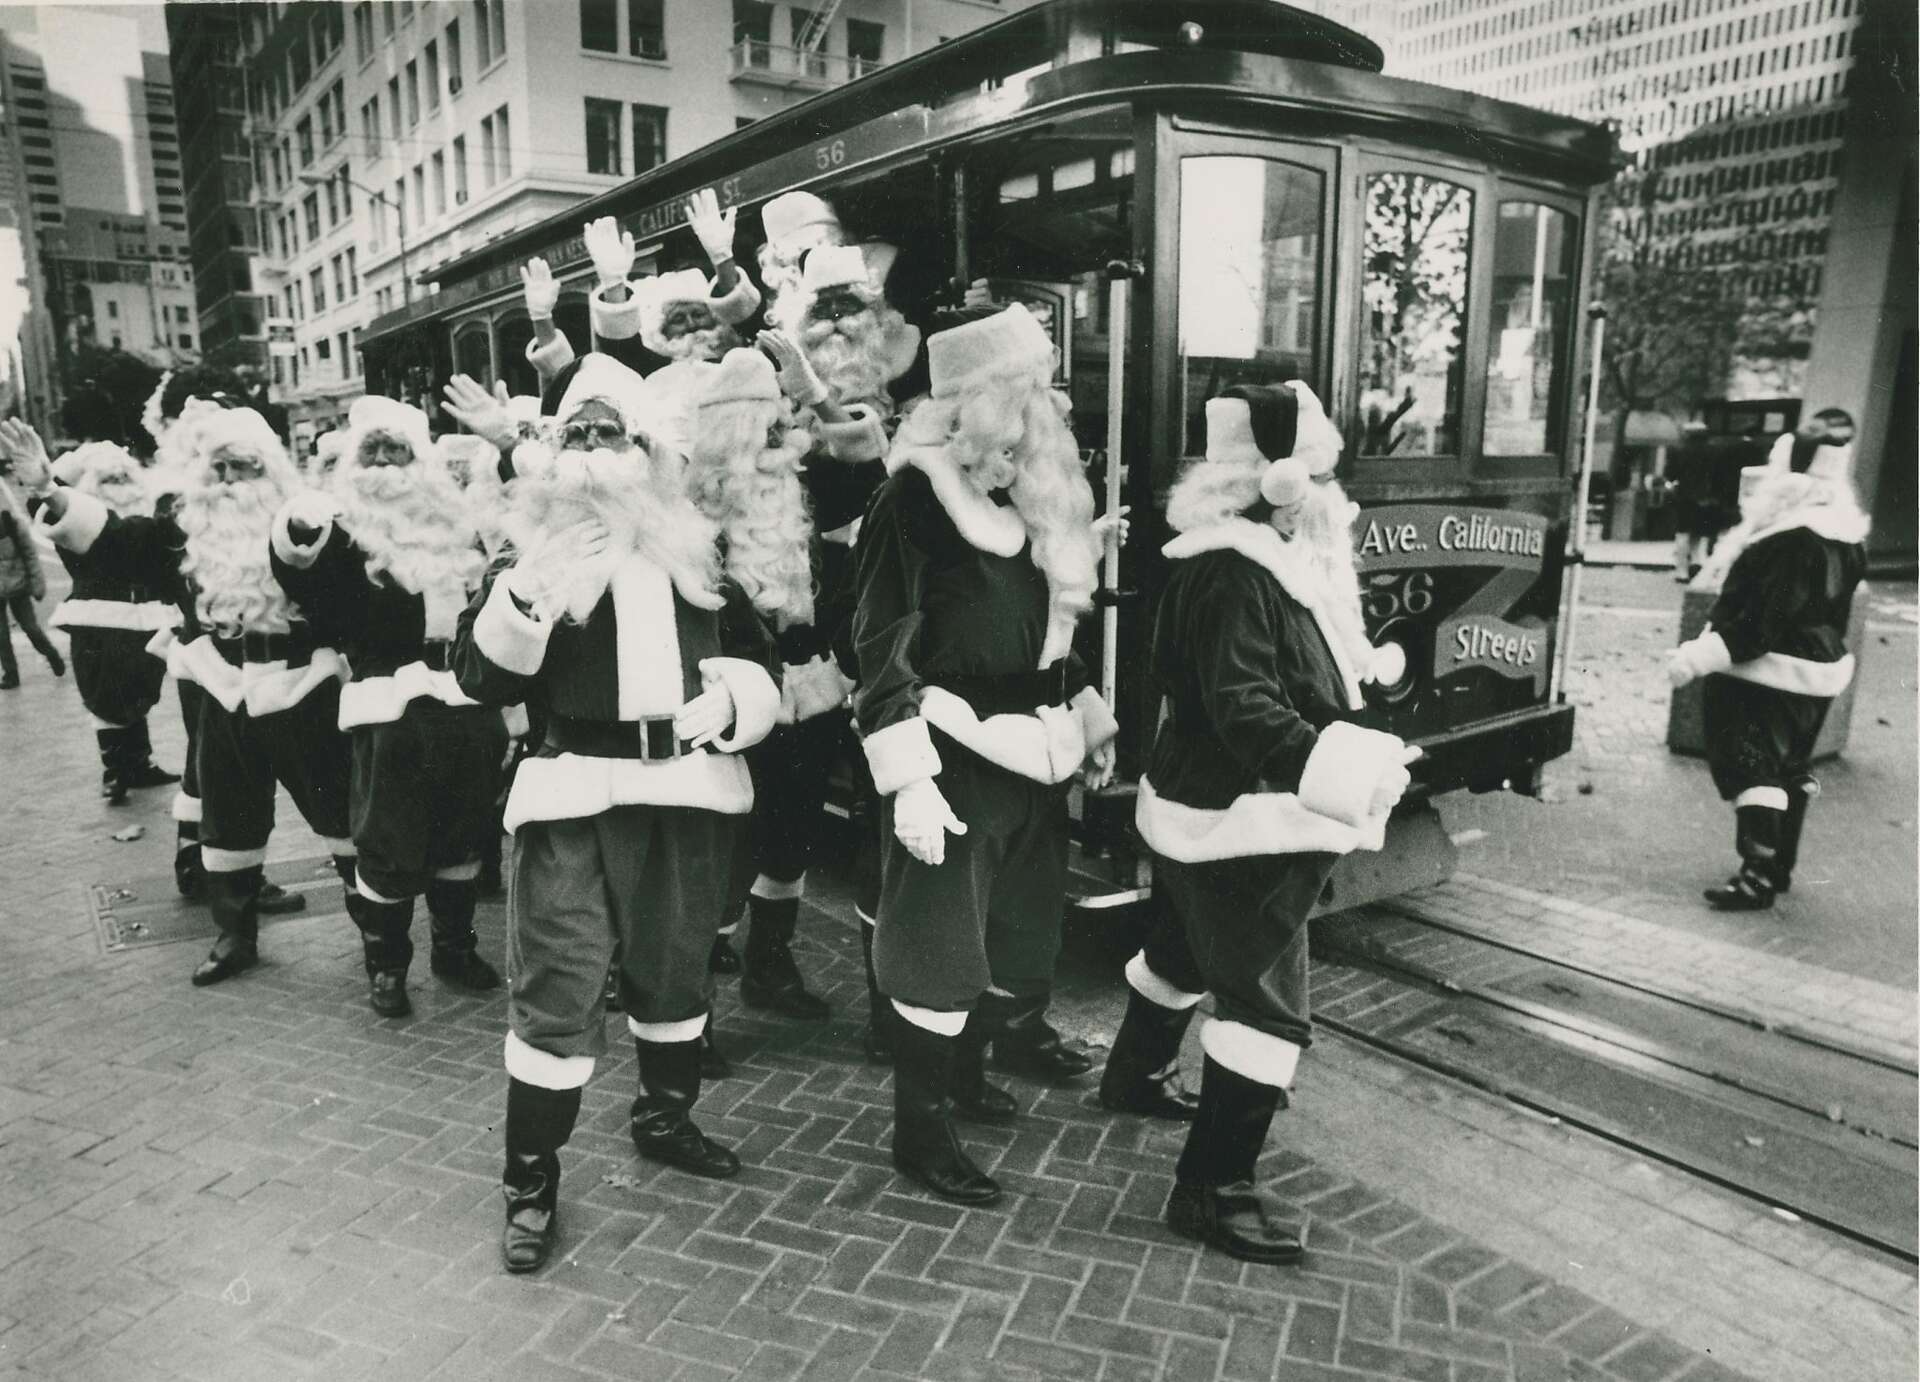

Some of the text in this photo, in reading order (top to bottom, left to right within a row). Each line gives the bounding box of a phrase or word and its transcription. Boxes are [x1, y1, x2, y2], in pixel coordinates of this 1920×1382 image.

[815, 140, 845, 169] 56
[1438, 514, 1543, 557] California
[1368, 572, 1434, 618] 56
[1454, 624, 1537, 667] Streets
